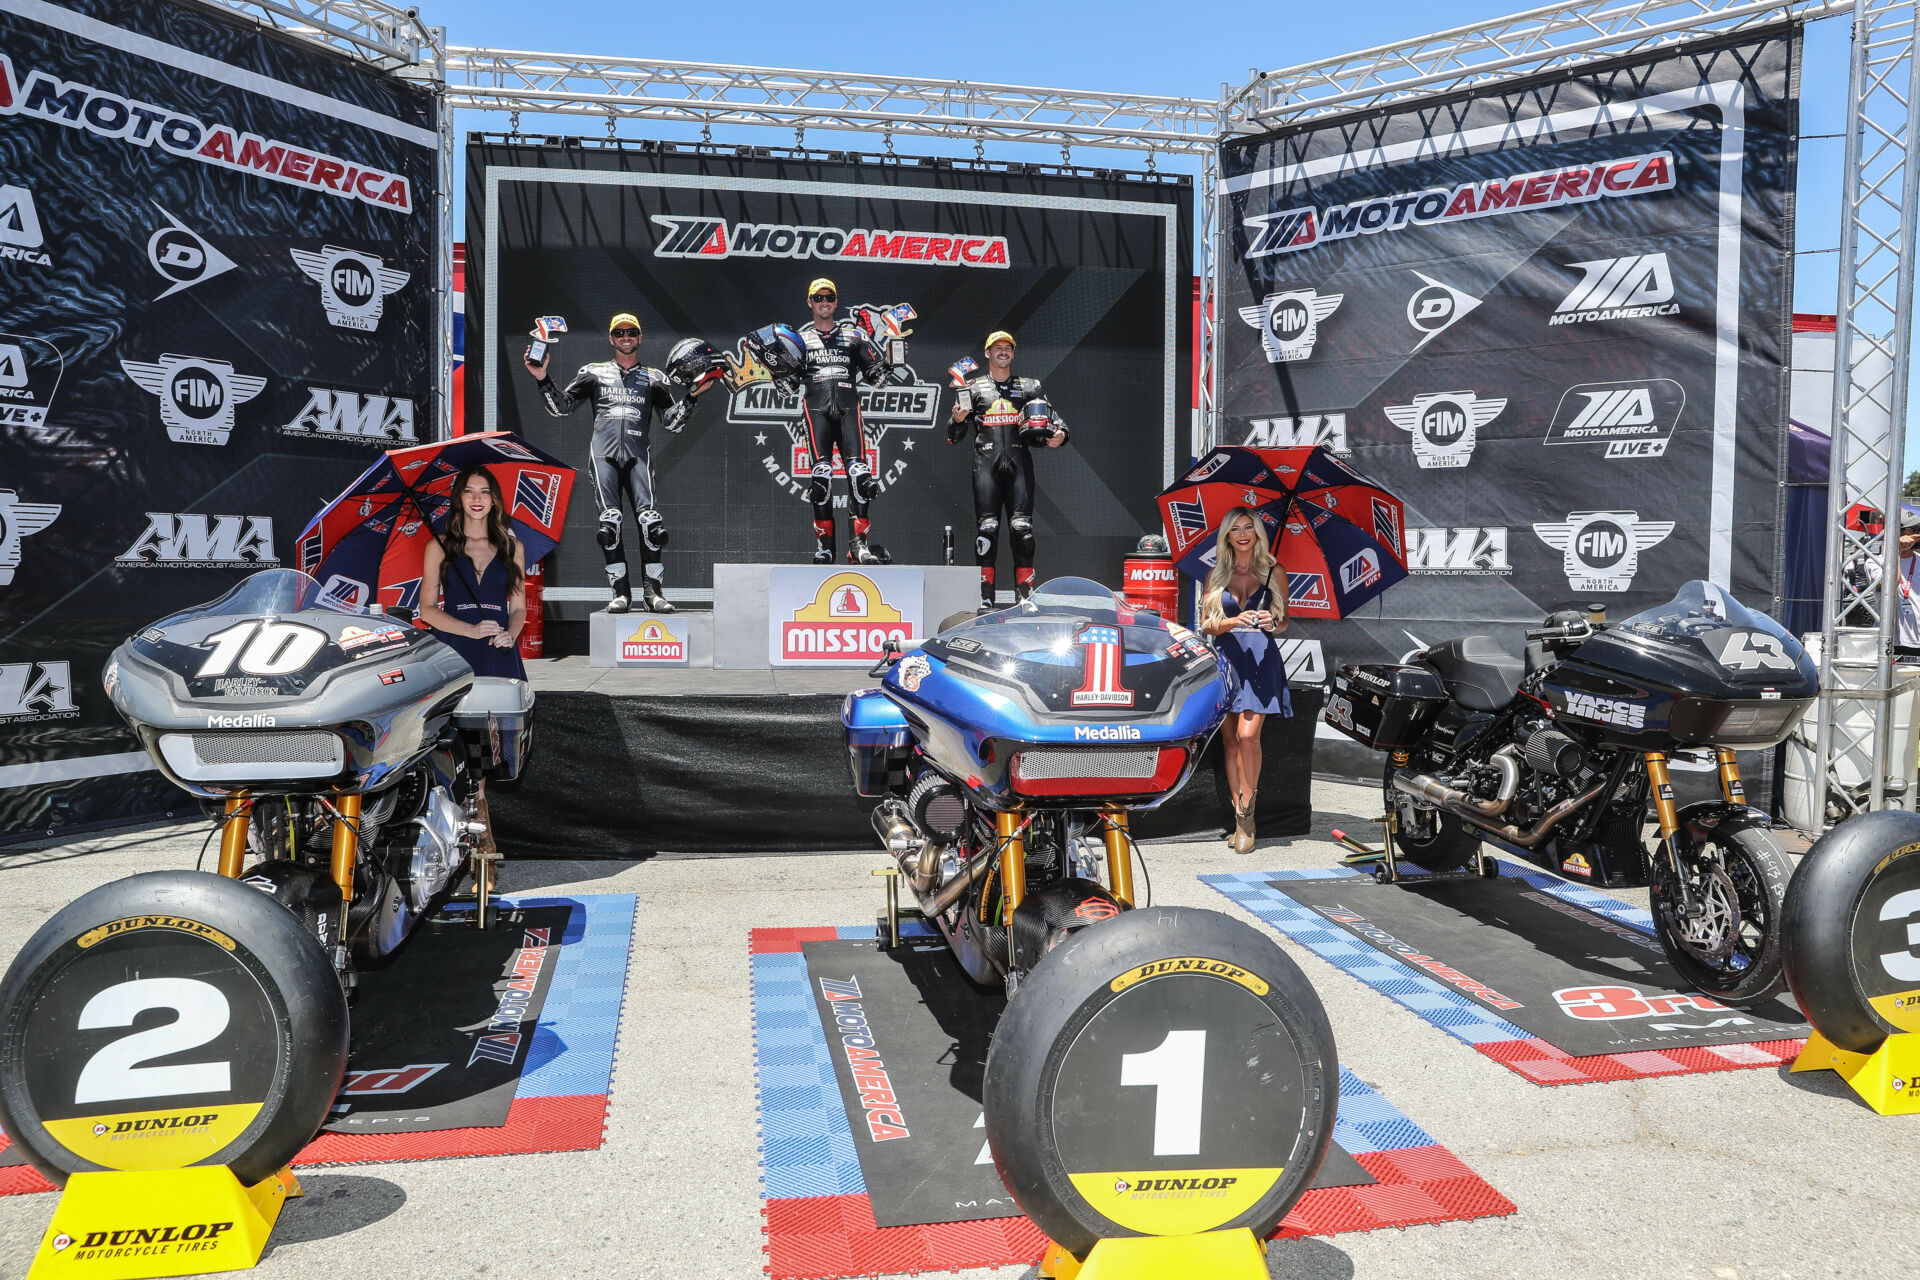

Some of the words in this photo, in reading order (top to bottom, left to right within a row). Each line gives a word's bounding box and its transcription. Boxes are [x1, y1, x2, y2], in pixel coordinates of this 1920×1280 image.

[24, 77, 409, 209] MOTOAMERICA
[1322, 155, 1670, 236] MOTOAMERICA
[732, 227, 1007, 265] MOTOAMERICA
[333, 268, 372, 296] FIM
[336, 319, 369, 330] AMERICA
[341, 314, 364, 323] NORTH
[1273, 308, 1306, 333] FIM
[1548, 304, 1681, 326] MOTOAMERICA
[816, 354, 850, 364] DAVIDSON
[174, 378, 222, 408] FIM
[608, 394, 646, 404] DAVIDSON
[744, 388, 799, 410] KING
[859, 391, 929, 413] GGERS
[282, 387, 420, 442] AMA
[1424, 412, 1464, 437] FIM
[179, 435, 219, 444] AMERICA
[185, 429, 213, 437] NORTH
[283, 430, 322, 439] AMERICAN
[322, 434, 375, 443] MOTORCYCLIST
[375, 438, 420, 447] ASSOCIATION
[1242, 413, 1352, 453] AMA
[1563, 426, 1659, 438] MOTOAMERICA
[1608, 441, 1664, 457] LIVE+
[1427, 460, 1460, 468] AMERICA
[542, 474, 562, 529] MOTOAMERICA
[115, 512, 281, 563] AMA
[1579, 531, 1623, 558] FIM
[1130, 569, 1175, 581] MOTUL
[1290, 600, 1330, 609] AMERICA
[195, 618, 330, 679] 10
[624, 644, 680, 657] MISSION
[787, 628, 906, 653] MISSION
[1719, 632, 1797, 670] 43
[1358, 670, 1391, 689] DUNLOP
[1327, 693, 1354, 732] 43
[1563, 690, 1647, 718] VANCE
[1566, 701, 1645, 729] HINES
[13, 711, 80, 725] ASSOCIATION
[207, 713, 276, 729] Medallia
[1074, 725, 1141, 741] Medallia
[1563, 863, 1592, 876] MISSION
[105, 916, 212, 936] DUNLOP
[1138, 959, 1246, 979] DUNLOP
[1345, 921, 1526, 1011] MOTOAMERICA
[75, 977, 232, 1105] 2
[1608, 1033, 1696, 1046] MATRIX
[1704, 1024, 1815, 1038] CONCEPT
[830, 1001, 911, 1143] MOTOAMERICA
[1120, 1029, 1207, 1156] 1
[110, 1129, 176, 1142] MOTORCYCLE
[181, 1126, 211, 1135] TIRES
[113, 1114, 219, 1133] DUNLOP
[1130, 1191, 1199, 1200] MOTORCYCLE
[1199, 1190, 1228, 1199] TIRES
[1133, 1177, 1237, 1192] DUNLOP
[79, 1222, 234, 1249] DUNLOP
[74, 1243, 167, 1261] MOTORCYCLE
[176, 1240, 219, 1252] TIRES
